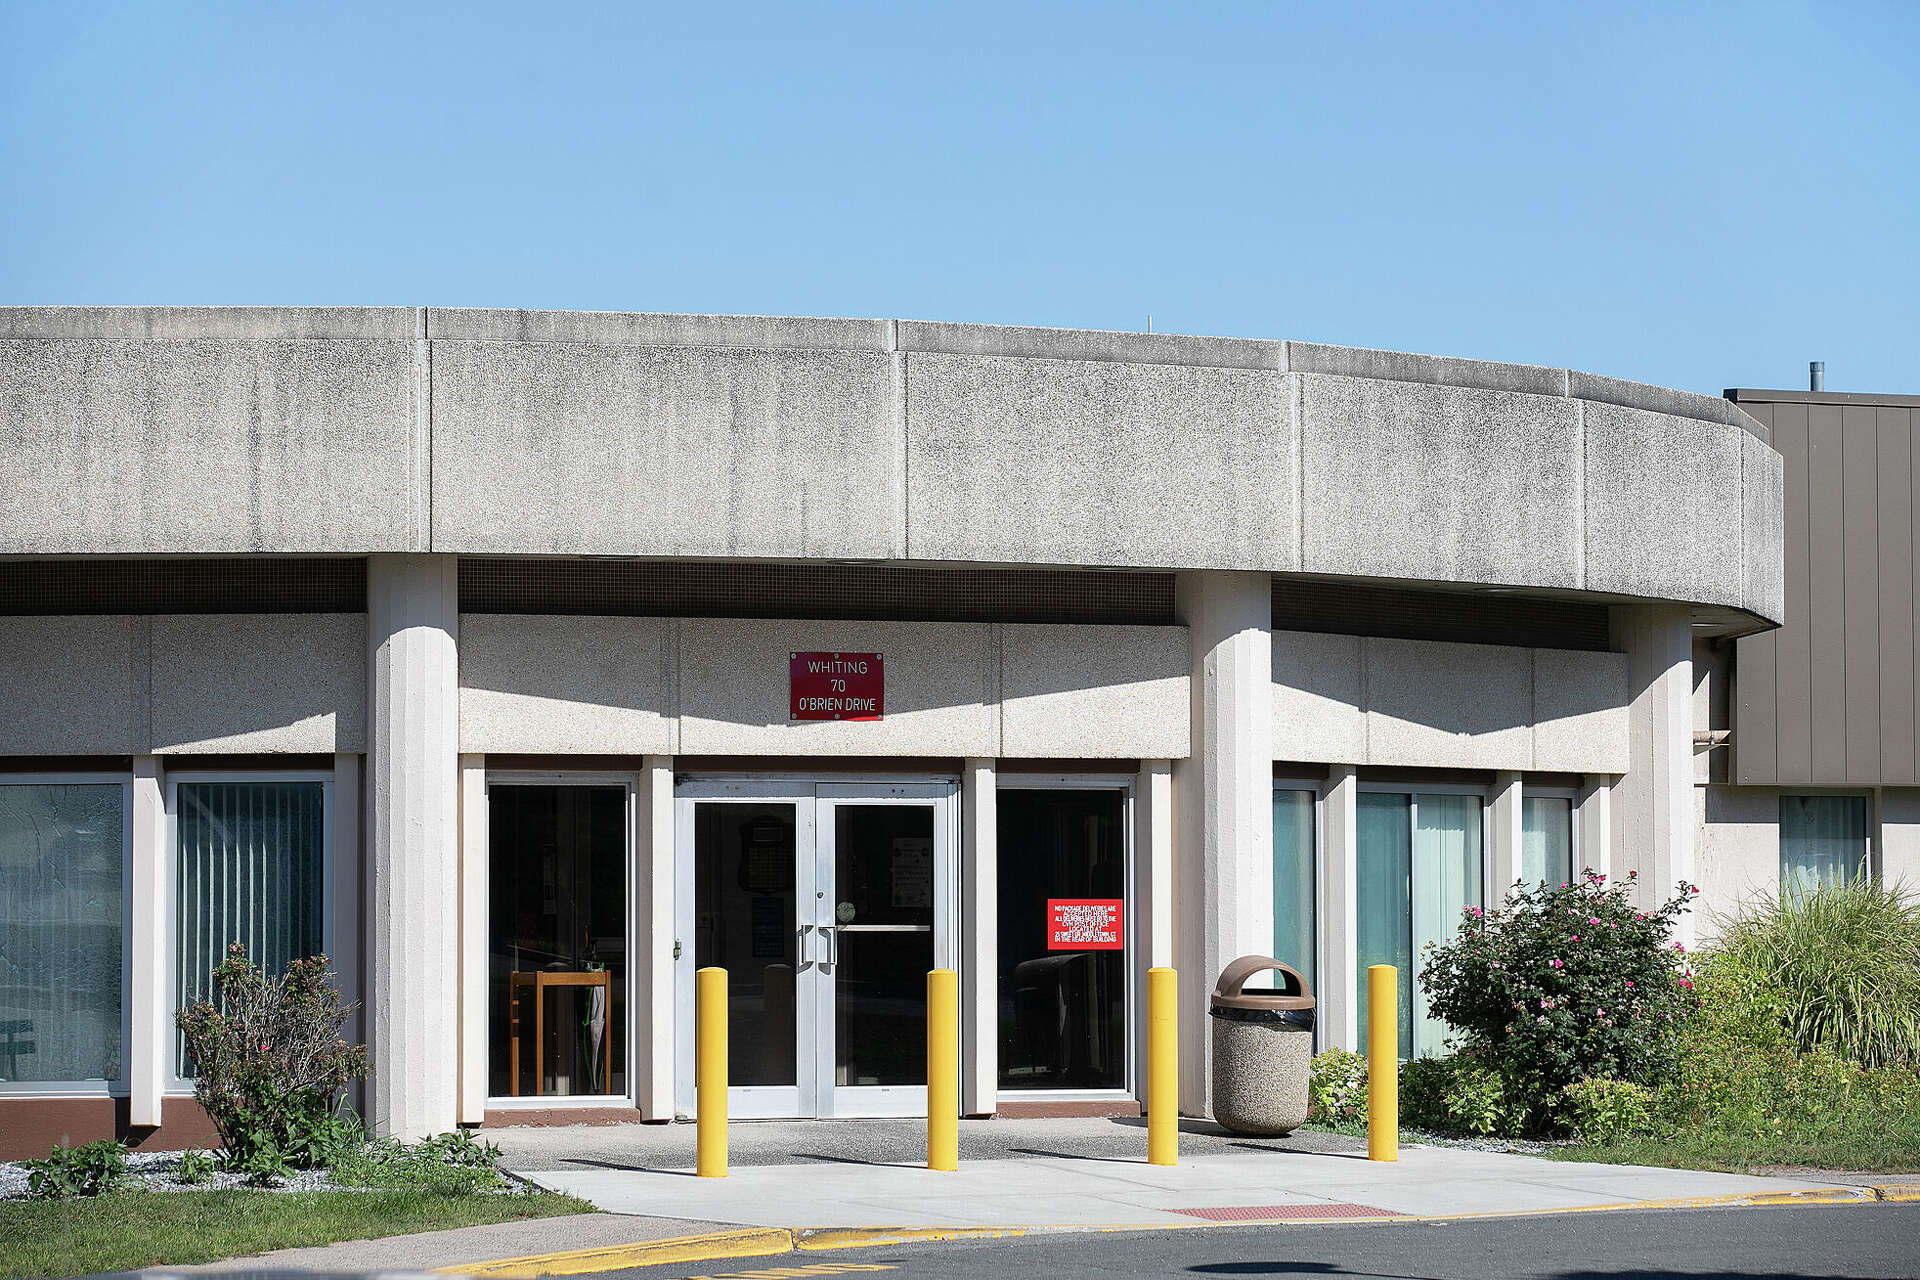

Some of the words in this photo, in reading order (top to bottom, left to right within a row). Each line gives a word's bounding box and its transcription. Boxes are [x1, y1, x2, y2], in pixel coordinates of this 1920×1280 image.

[807, 661, 868, 674] WHITING
[830, 679, 846, 692] 70
[799, 697, 842, 711] O'BRIEN
[845, 697, 876, 711] DRIVE
